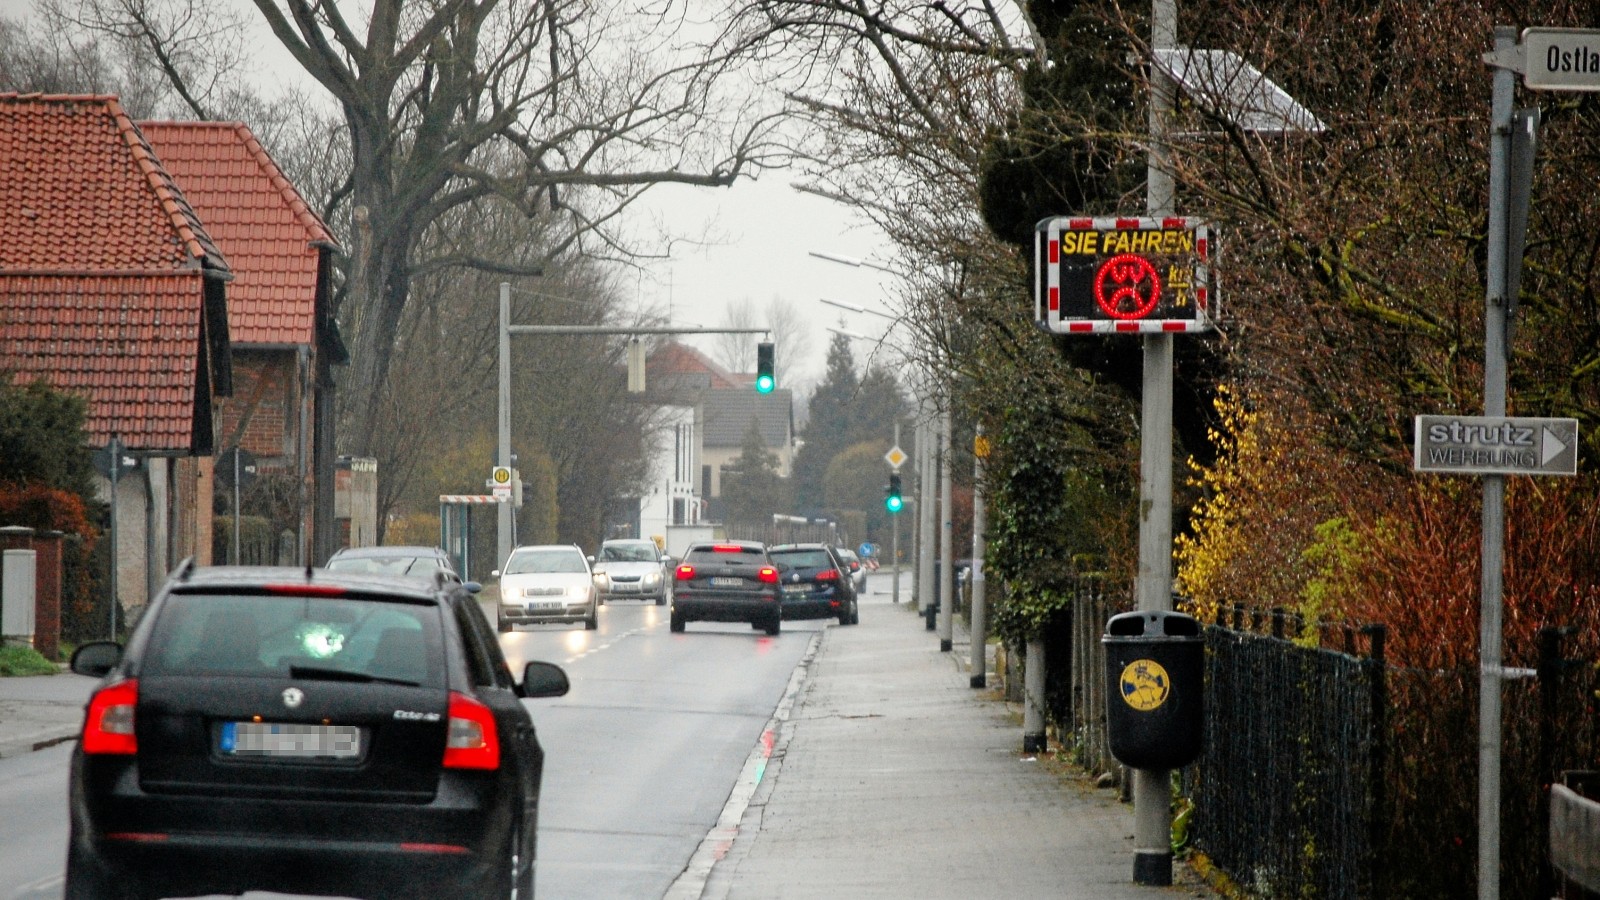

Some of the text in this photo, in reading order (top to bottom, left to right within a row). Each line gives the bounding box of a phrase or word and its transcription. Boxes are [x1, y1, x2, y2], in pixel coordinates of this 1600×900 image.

[1547, 45, 1600, 73] Ostla
[1062, 231, 1193, 254] SIE FAHREN
[1429, 421, 1534, 446] strutz
[1429, 448, 1535, 467] WERBUNG
